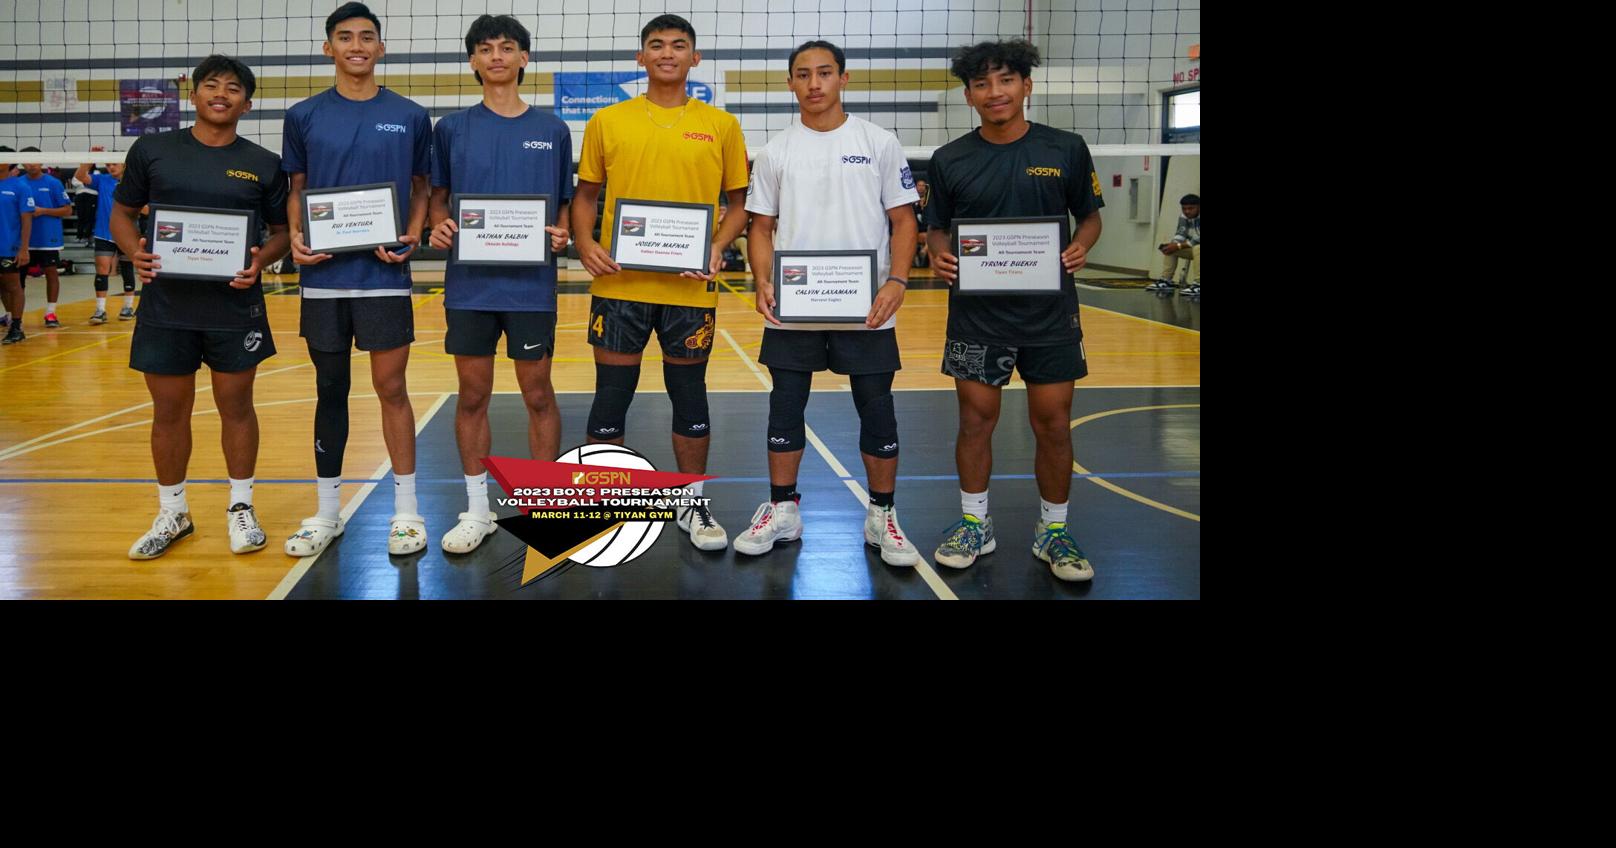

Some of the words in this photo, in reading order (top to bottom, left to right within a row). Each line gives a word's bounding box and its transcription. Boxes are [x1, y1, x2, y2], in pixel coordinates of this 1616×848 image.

[562, 96, 619, 104] Connections
[562, 106, 581, 114] that
[530, 141, 552, 150] GSPN
[1034, 167, 1060, 176] GSPN
